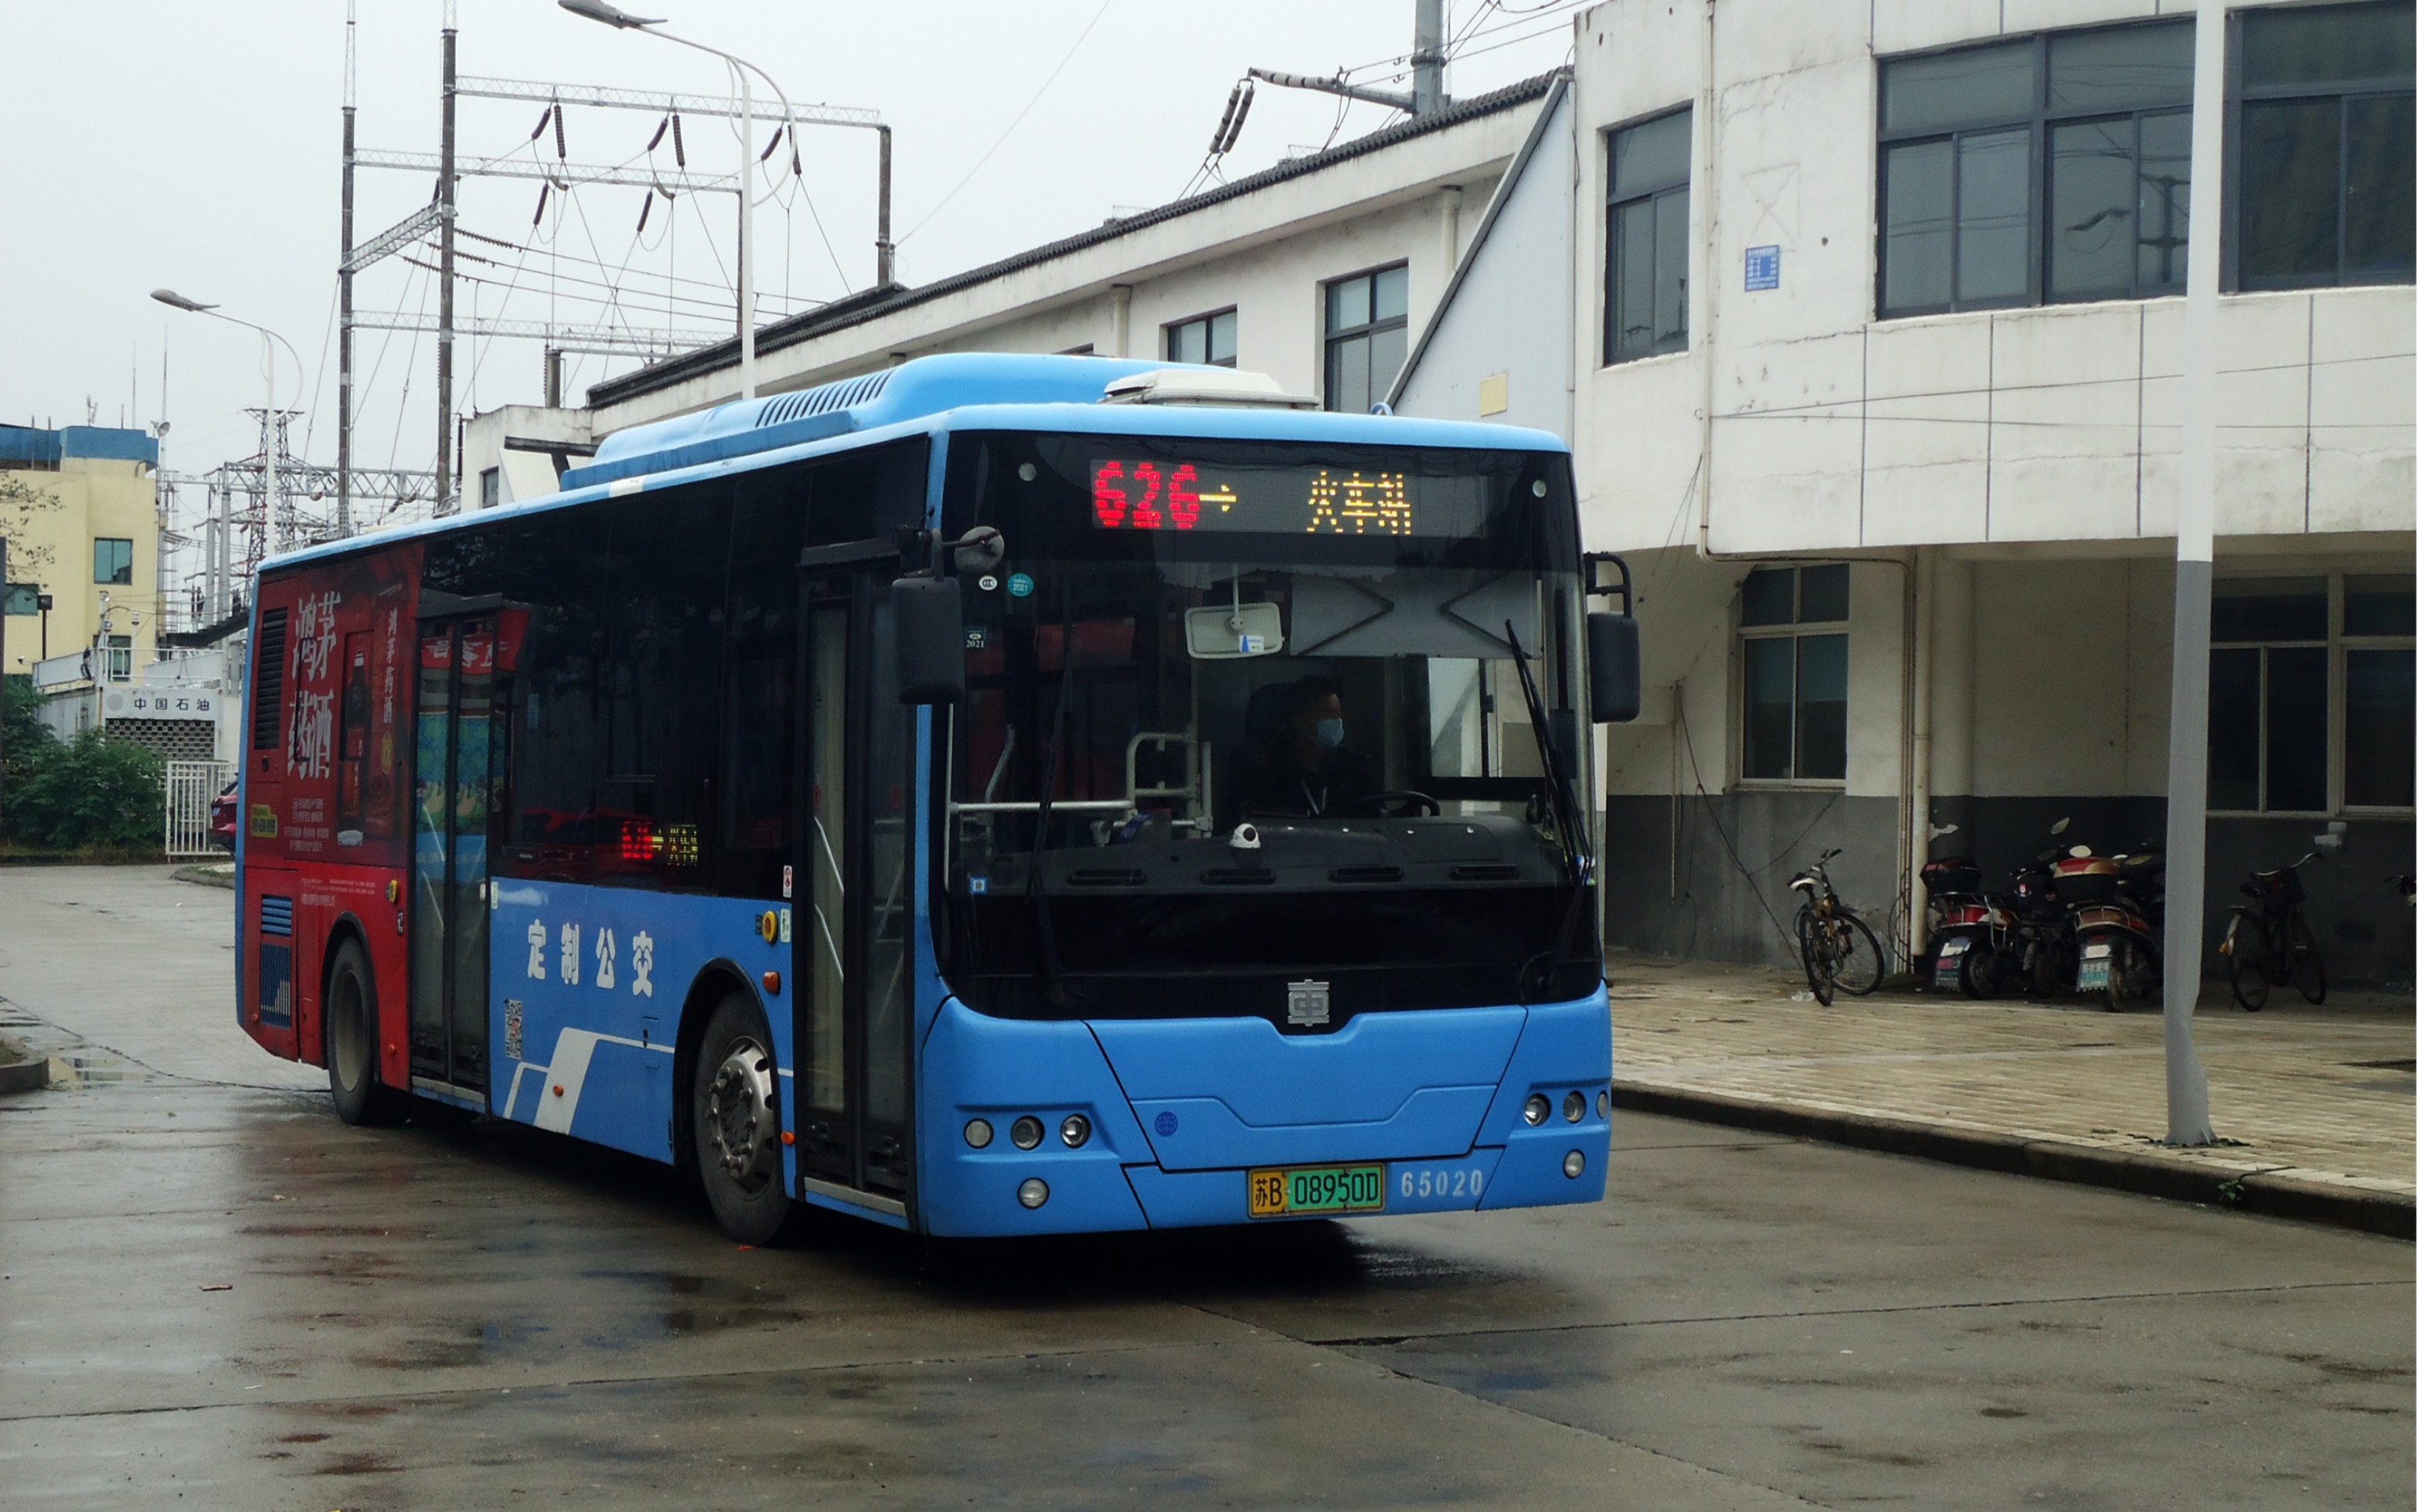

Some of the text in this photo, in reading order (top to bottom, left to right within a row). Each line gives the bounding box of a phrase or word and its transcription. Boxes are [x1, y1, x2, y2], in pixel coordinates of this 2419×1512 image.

[1095, 461, 1199, 529] 626
[1307, 471, 1410, 535] 火车站
[1012, 583, 1028, 592] 2021
[966, 640, 984, 648] 2021
[134, 697, 210, 712] 中国石油
[287, 688, 335, 780] 药酒
[527, 918, 654, 997] 定制公交
[1401, 1169, 1483, 1198] 65020
